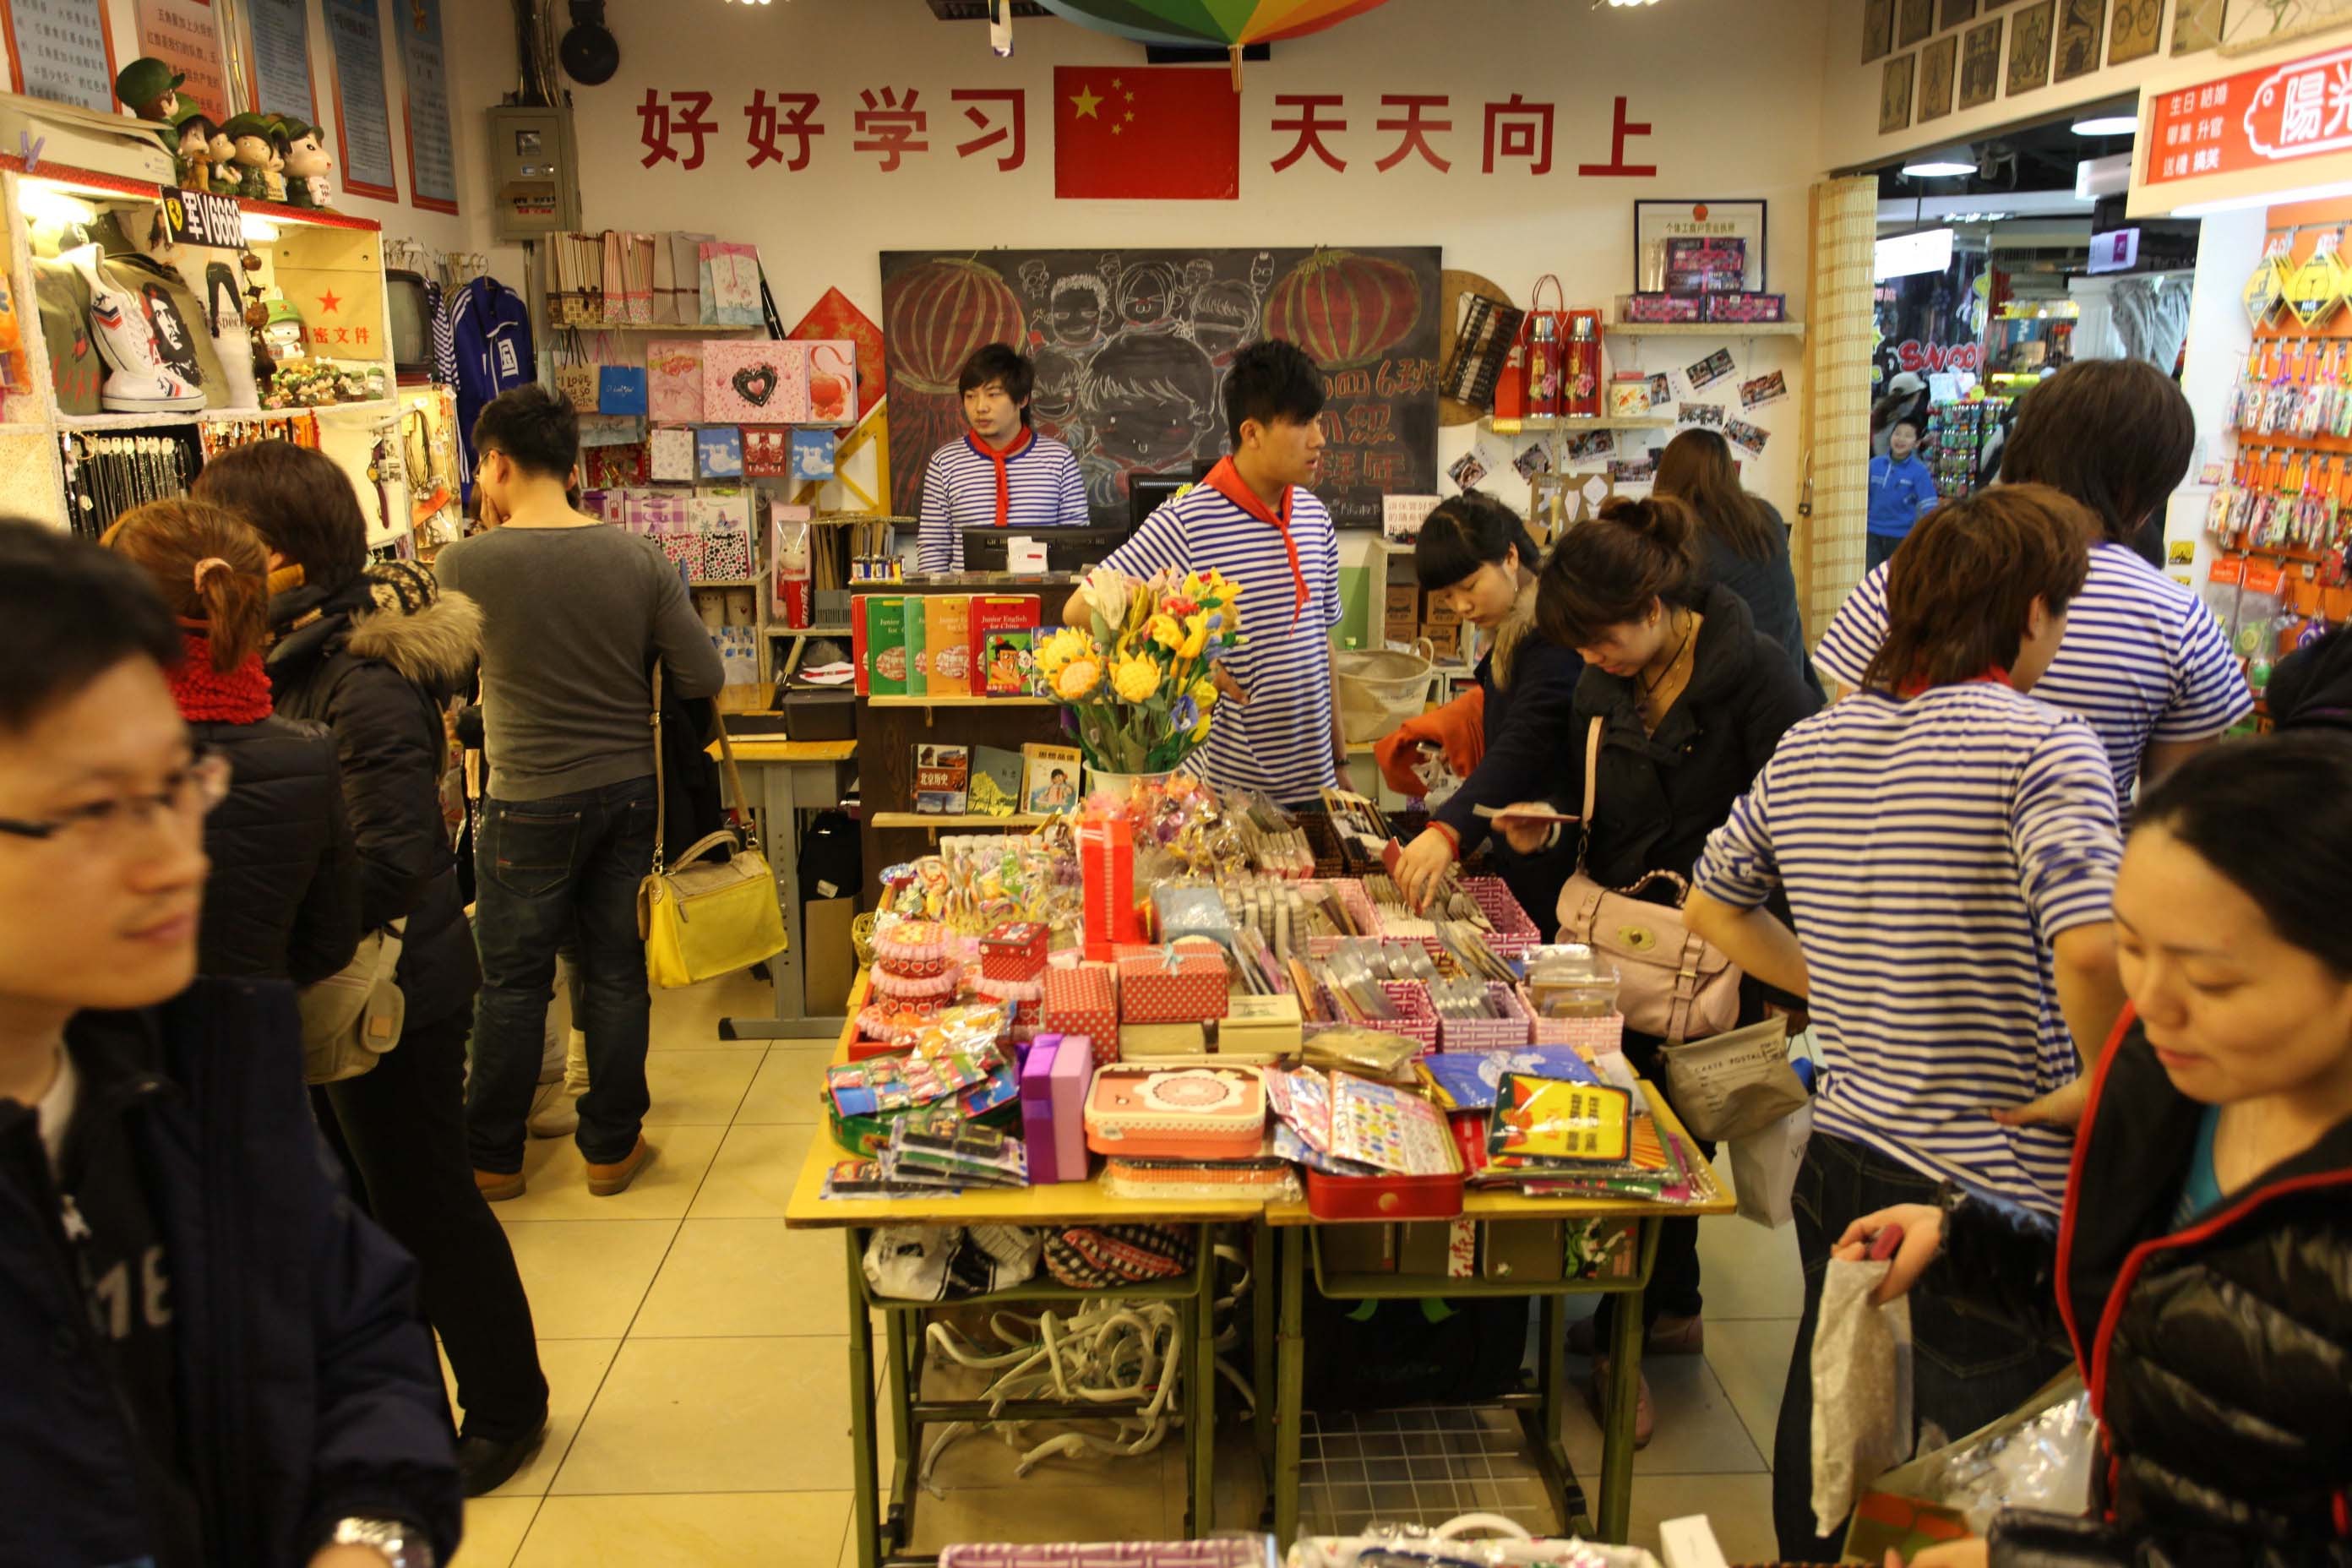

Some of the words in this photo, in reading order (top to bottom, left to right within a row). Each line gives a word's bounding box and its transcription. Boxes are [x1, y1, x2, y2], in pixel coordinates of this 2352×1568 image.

[2170, 91, 2195, 117] 生日
[2200, 82, 2229, 109] 結婚
[636, 87, 1026, 173] 好好学习
[1270, 93, 1658, 177] 天天向上
[2197, 116, 2224, 141] 升官
[982, 615, 1001, 623] Junior
[1004, 615, 1027, 623] English
